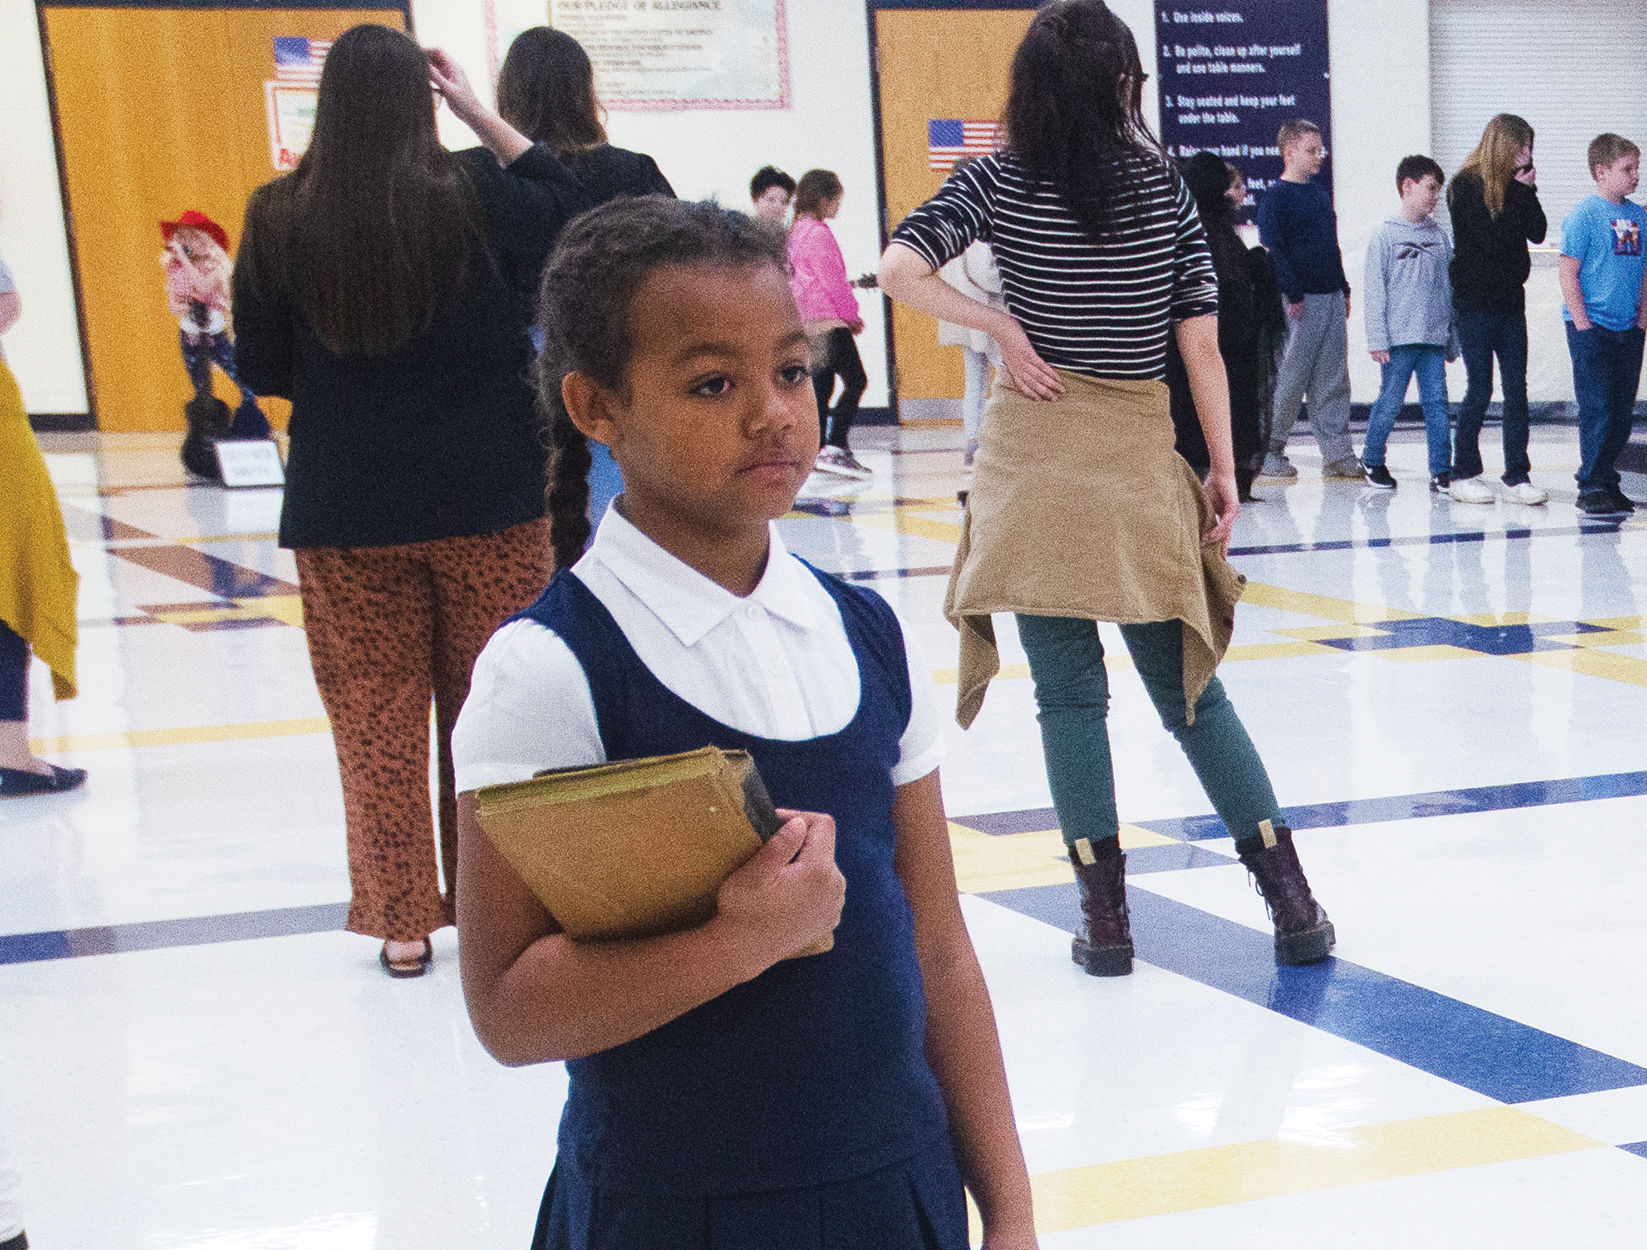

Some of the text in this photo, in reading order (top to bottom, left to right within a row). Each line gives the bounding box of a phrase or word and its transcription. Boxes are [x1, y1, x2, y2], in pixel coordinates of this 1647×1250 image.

[1161, 10, 1244, 23] 1. Use inside voices.
[1163, 43, 1302, 59] 2. Be polite, clean up after yourself
[1176, 61, 1267, 74] and use table manners.
[1165, 93, 1296, 110] 3. Stay seated and keep your feet
[1178, 110, 1240, 124] under the table.
[1221, 144, 1240, 157] hand
[1241, 144, 1249, 156] if
[1249, 146, 1264, 159] you
[1265, 146, 1281, 156] nee
